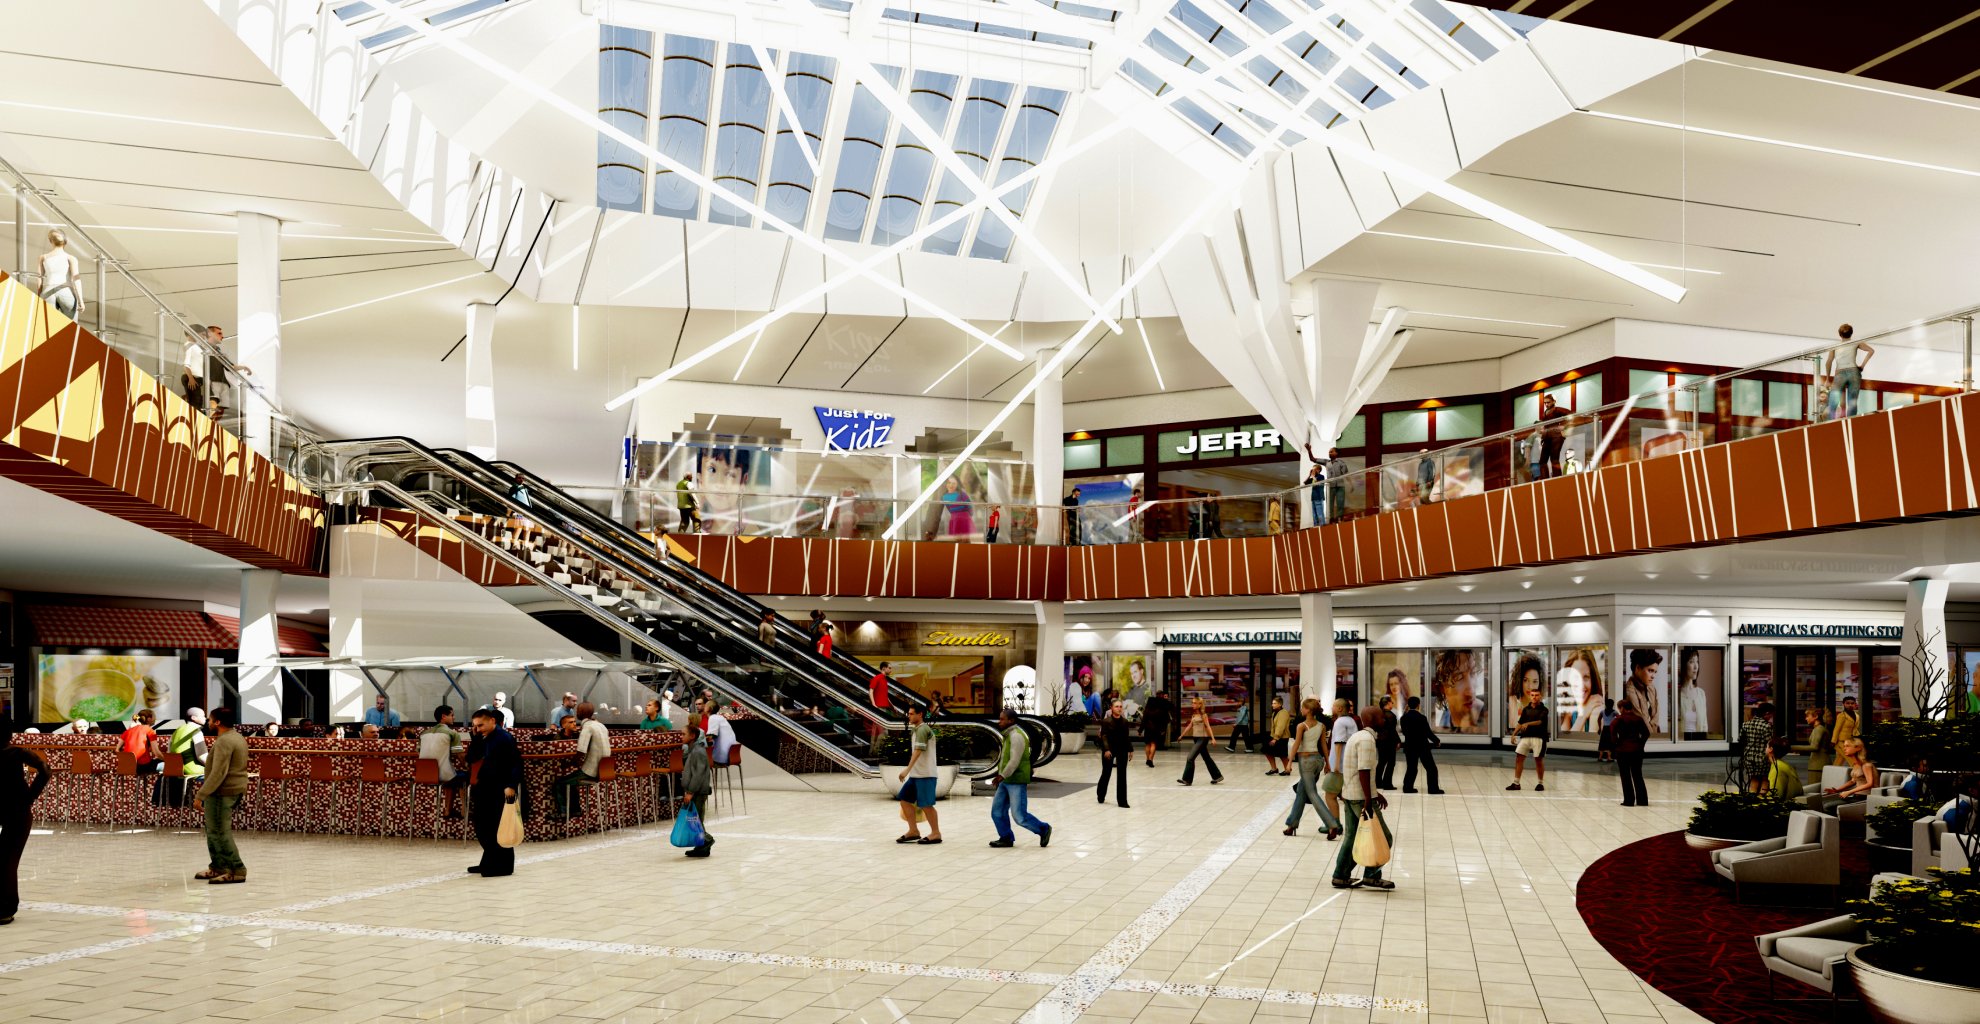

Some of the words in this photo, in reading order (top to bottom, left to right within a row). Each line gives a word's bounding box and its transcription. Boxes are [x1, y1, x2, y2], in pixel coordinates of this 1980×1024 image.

[823, 407, 859, 419] Just
[864, 409, 892, 420] For
[821, 420, 894, 458] Kidz
[1176, 428, 1282, 454] JERR
[1161, 632, 1233, 643] AMERICA'S
[1235, 631, 1302, 642] CLOTHIN
[1738, 623, 1808, 636] AMERICA'S
[1810, 624, 1875, 637] CLOTHING
[1876, 625, 1904, 638] STO
